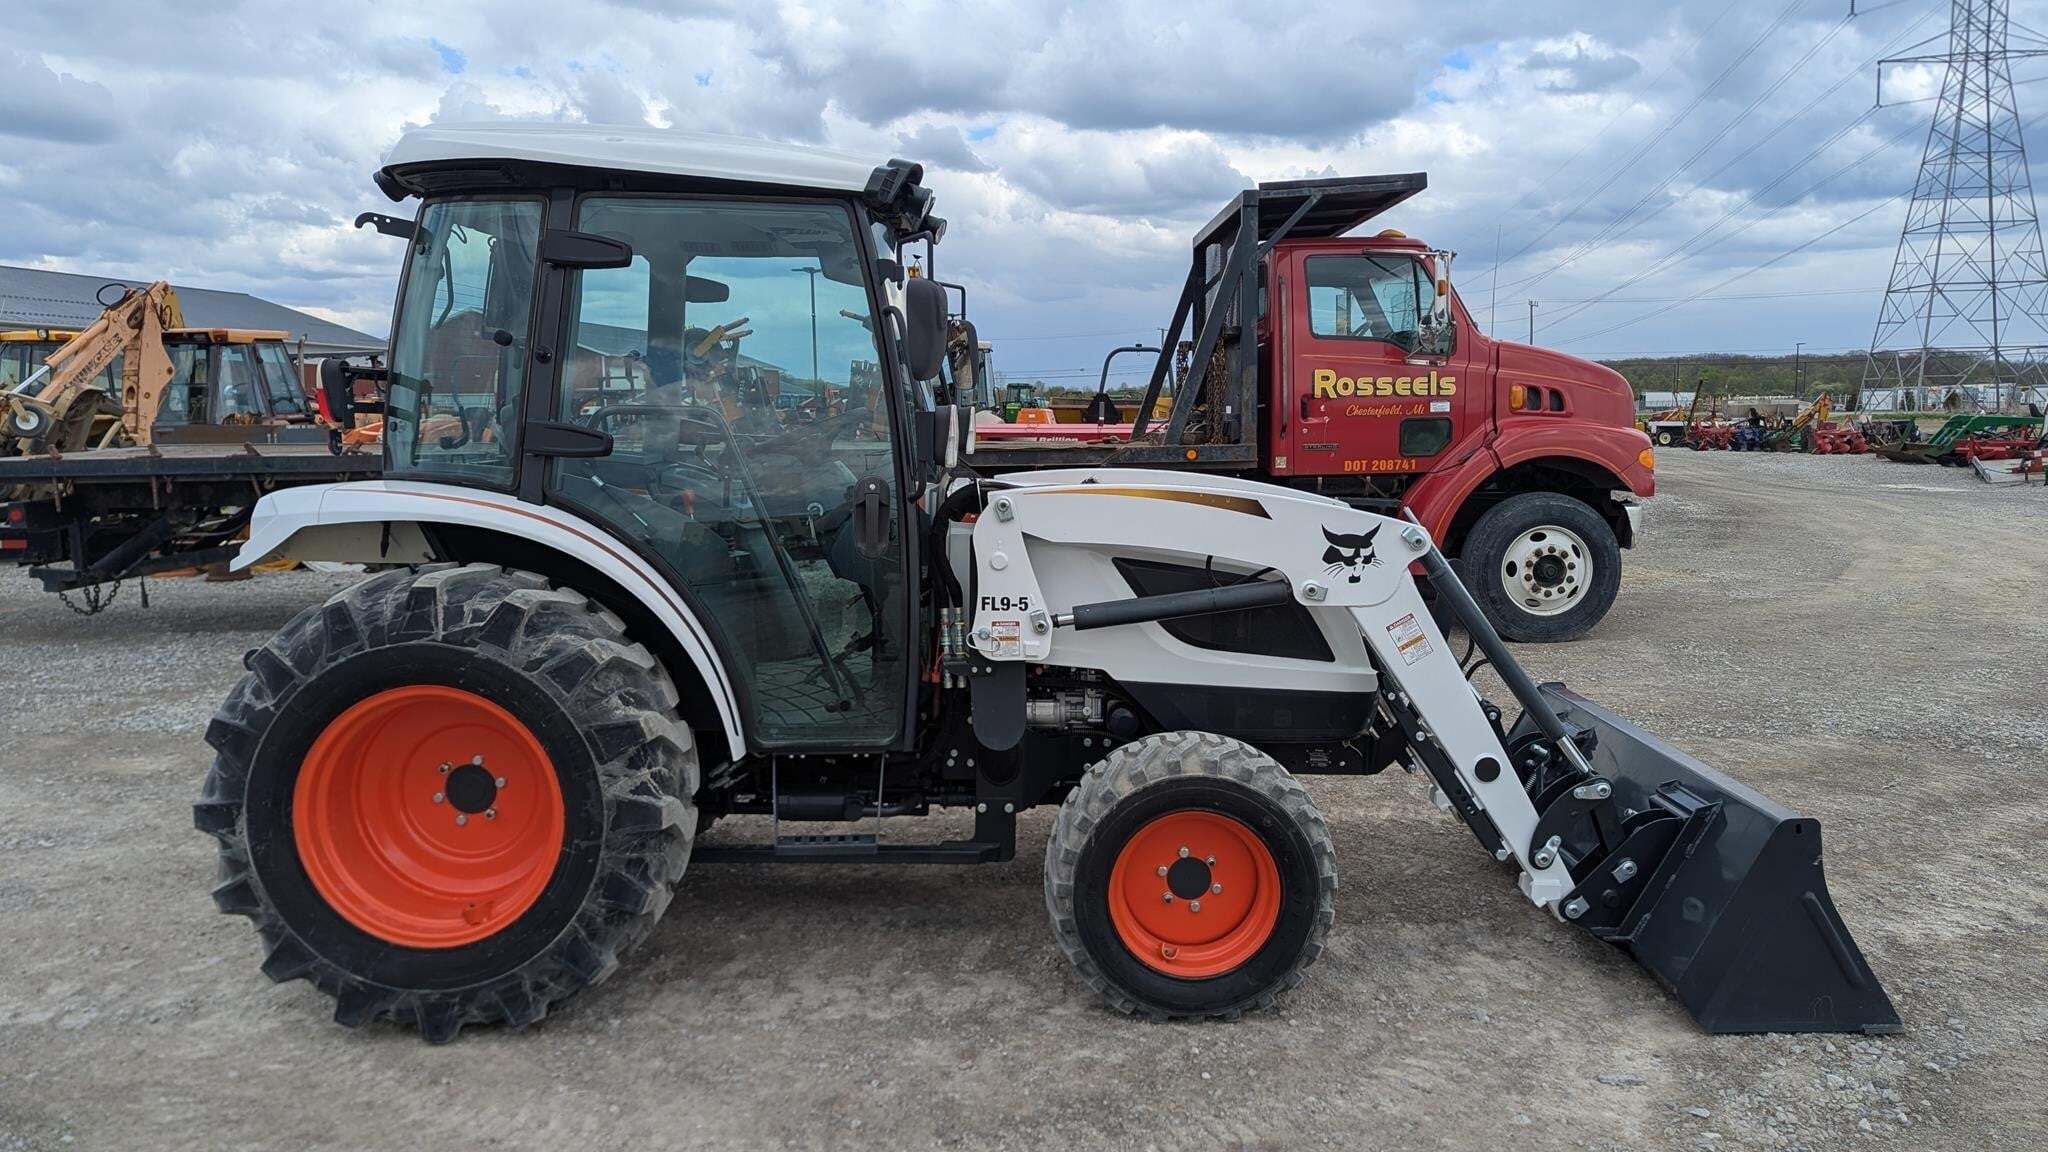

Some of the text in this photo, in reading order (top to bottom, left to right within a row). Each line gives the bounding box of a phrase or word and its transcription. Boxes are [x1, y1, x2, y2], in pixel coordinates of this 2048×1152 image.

[1312, 368, 1457, 399] Rosseels
[1344, 458, 1417, 472] DOT 208741
[981, 596, 1029, 611] FL9-5
